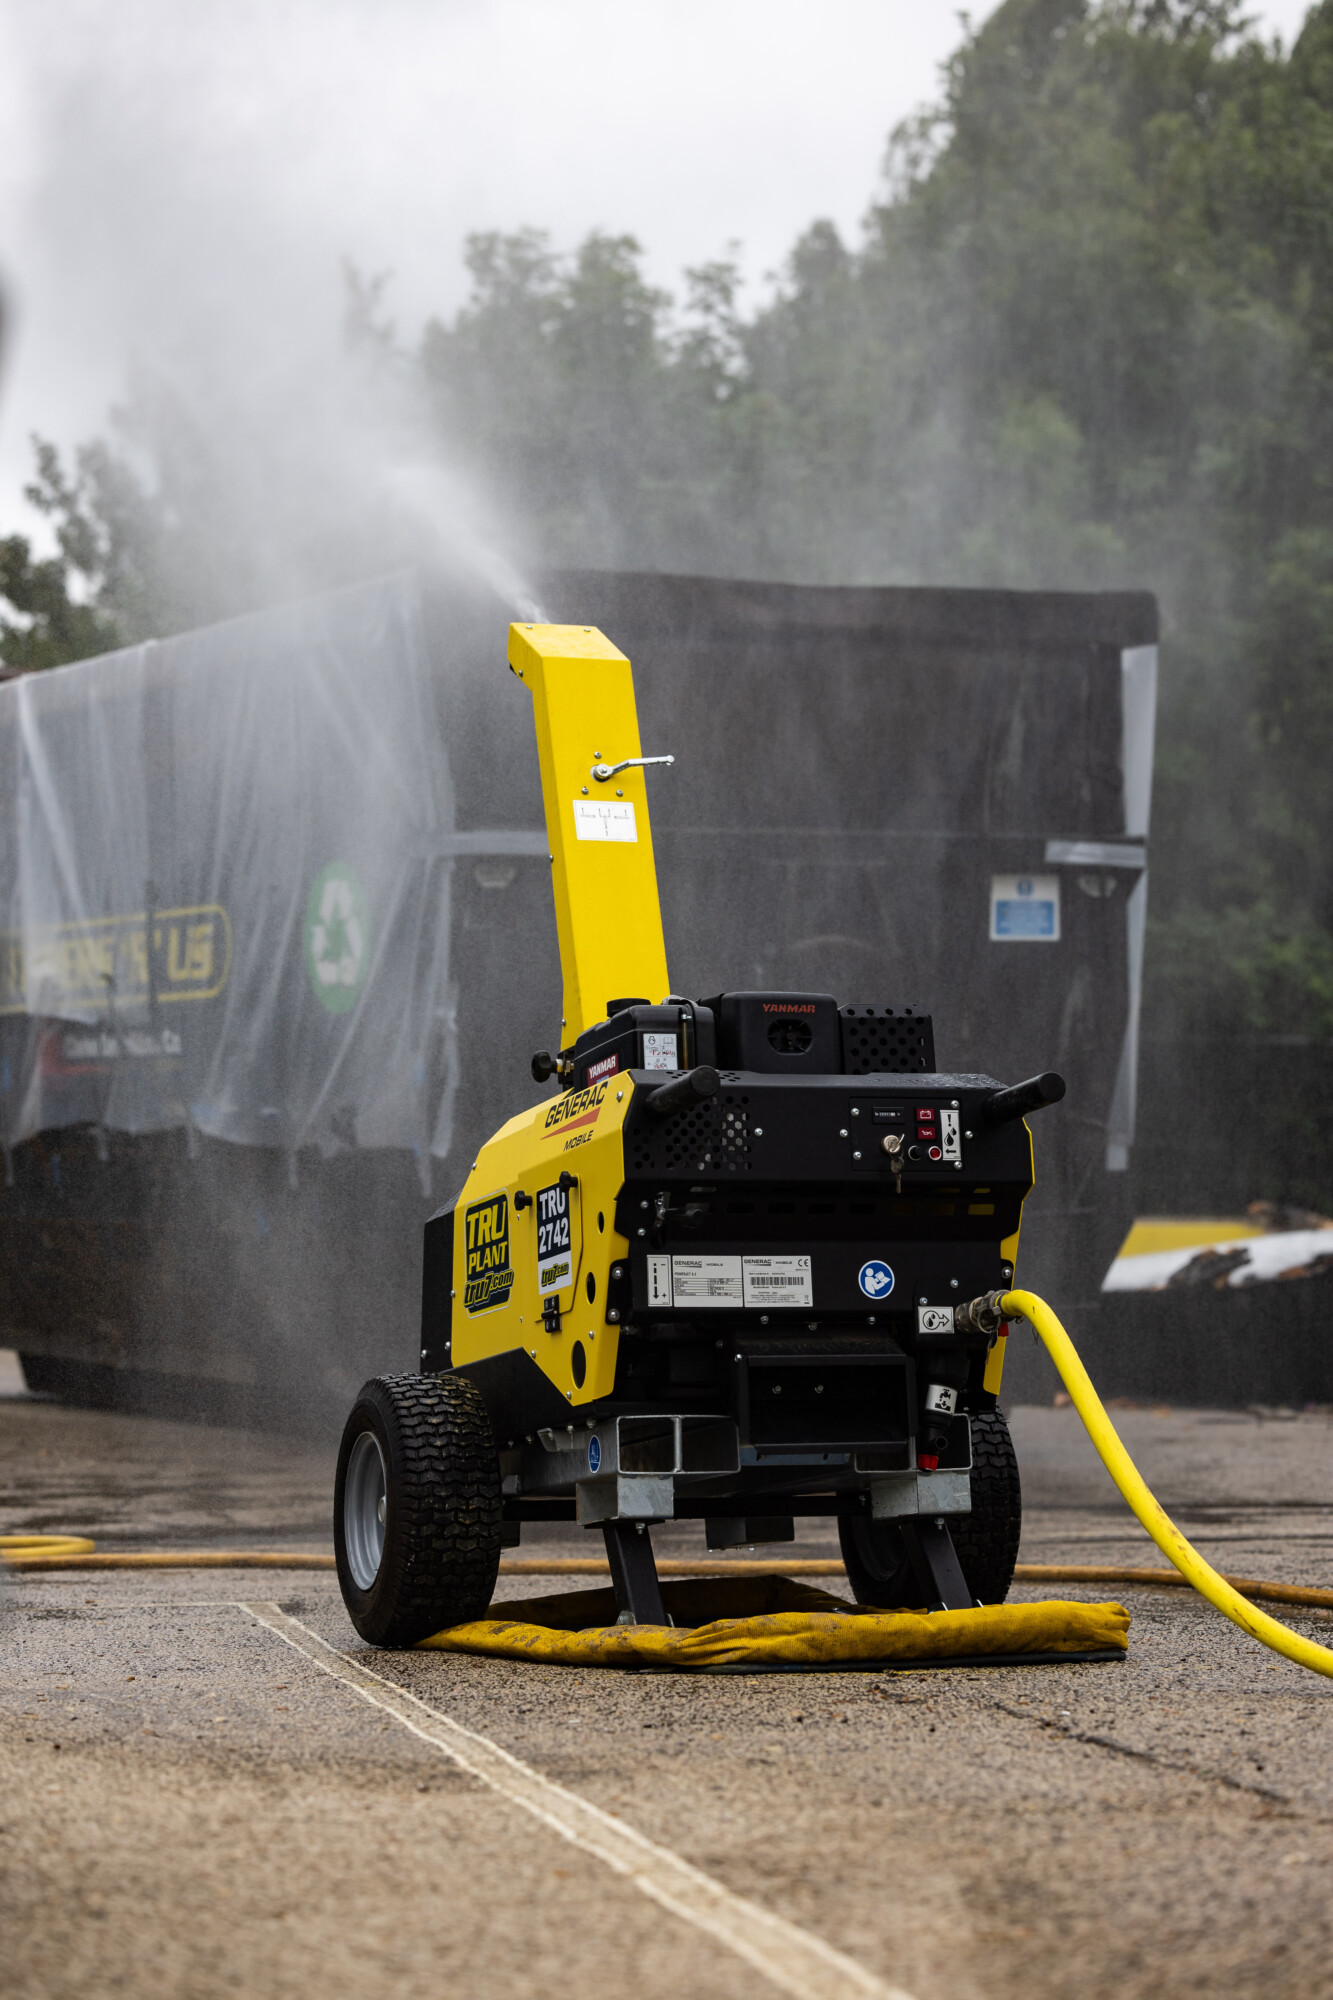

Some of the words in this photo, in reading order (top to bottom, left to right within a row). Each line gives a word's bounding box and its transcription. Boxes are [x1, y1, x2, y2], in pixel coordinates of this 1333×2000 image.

[762, 1003, 816, 1014] YANMAR
[588, 1056, 616, 1079] YANMAR
[545, 1081, 609, 1129] GENERAC
[563, 1129, 594, 1152] MOBILE
[540, 1187, 566, 1220] TRU
[467, 1201, 507, 1250] TRU
[539, 1217, 569, 1254] 2742
[468, 1241, 508, 1275] PLANT
[541, 1262, 569, 1287] tru7.com
[464, 1269, 514, 1307] tru7.com
